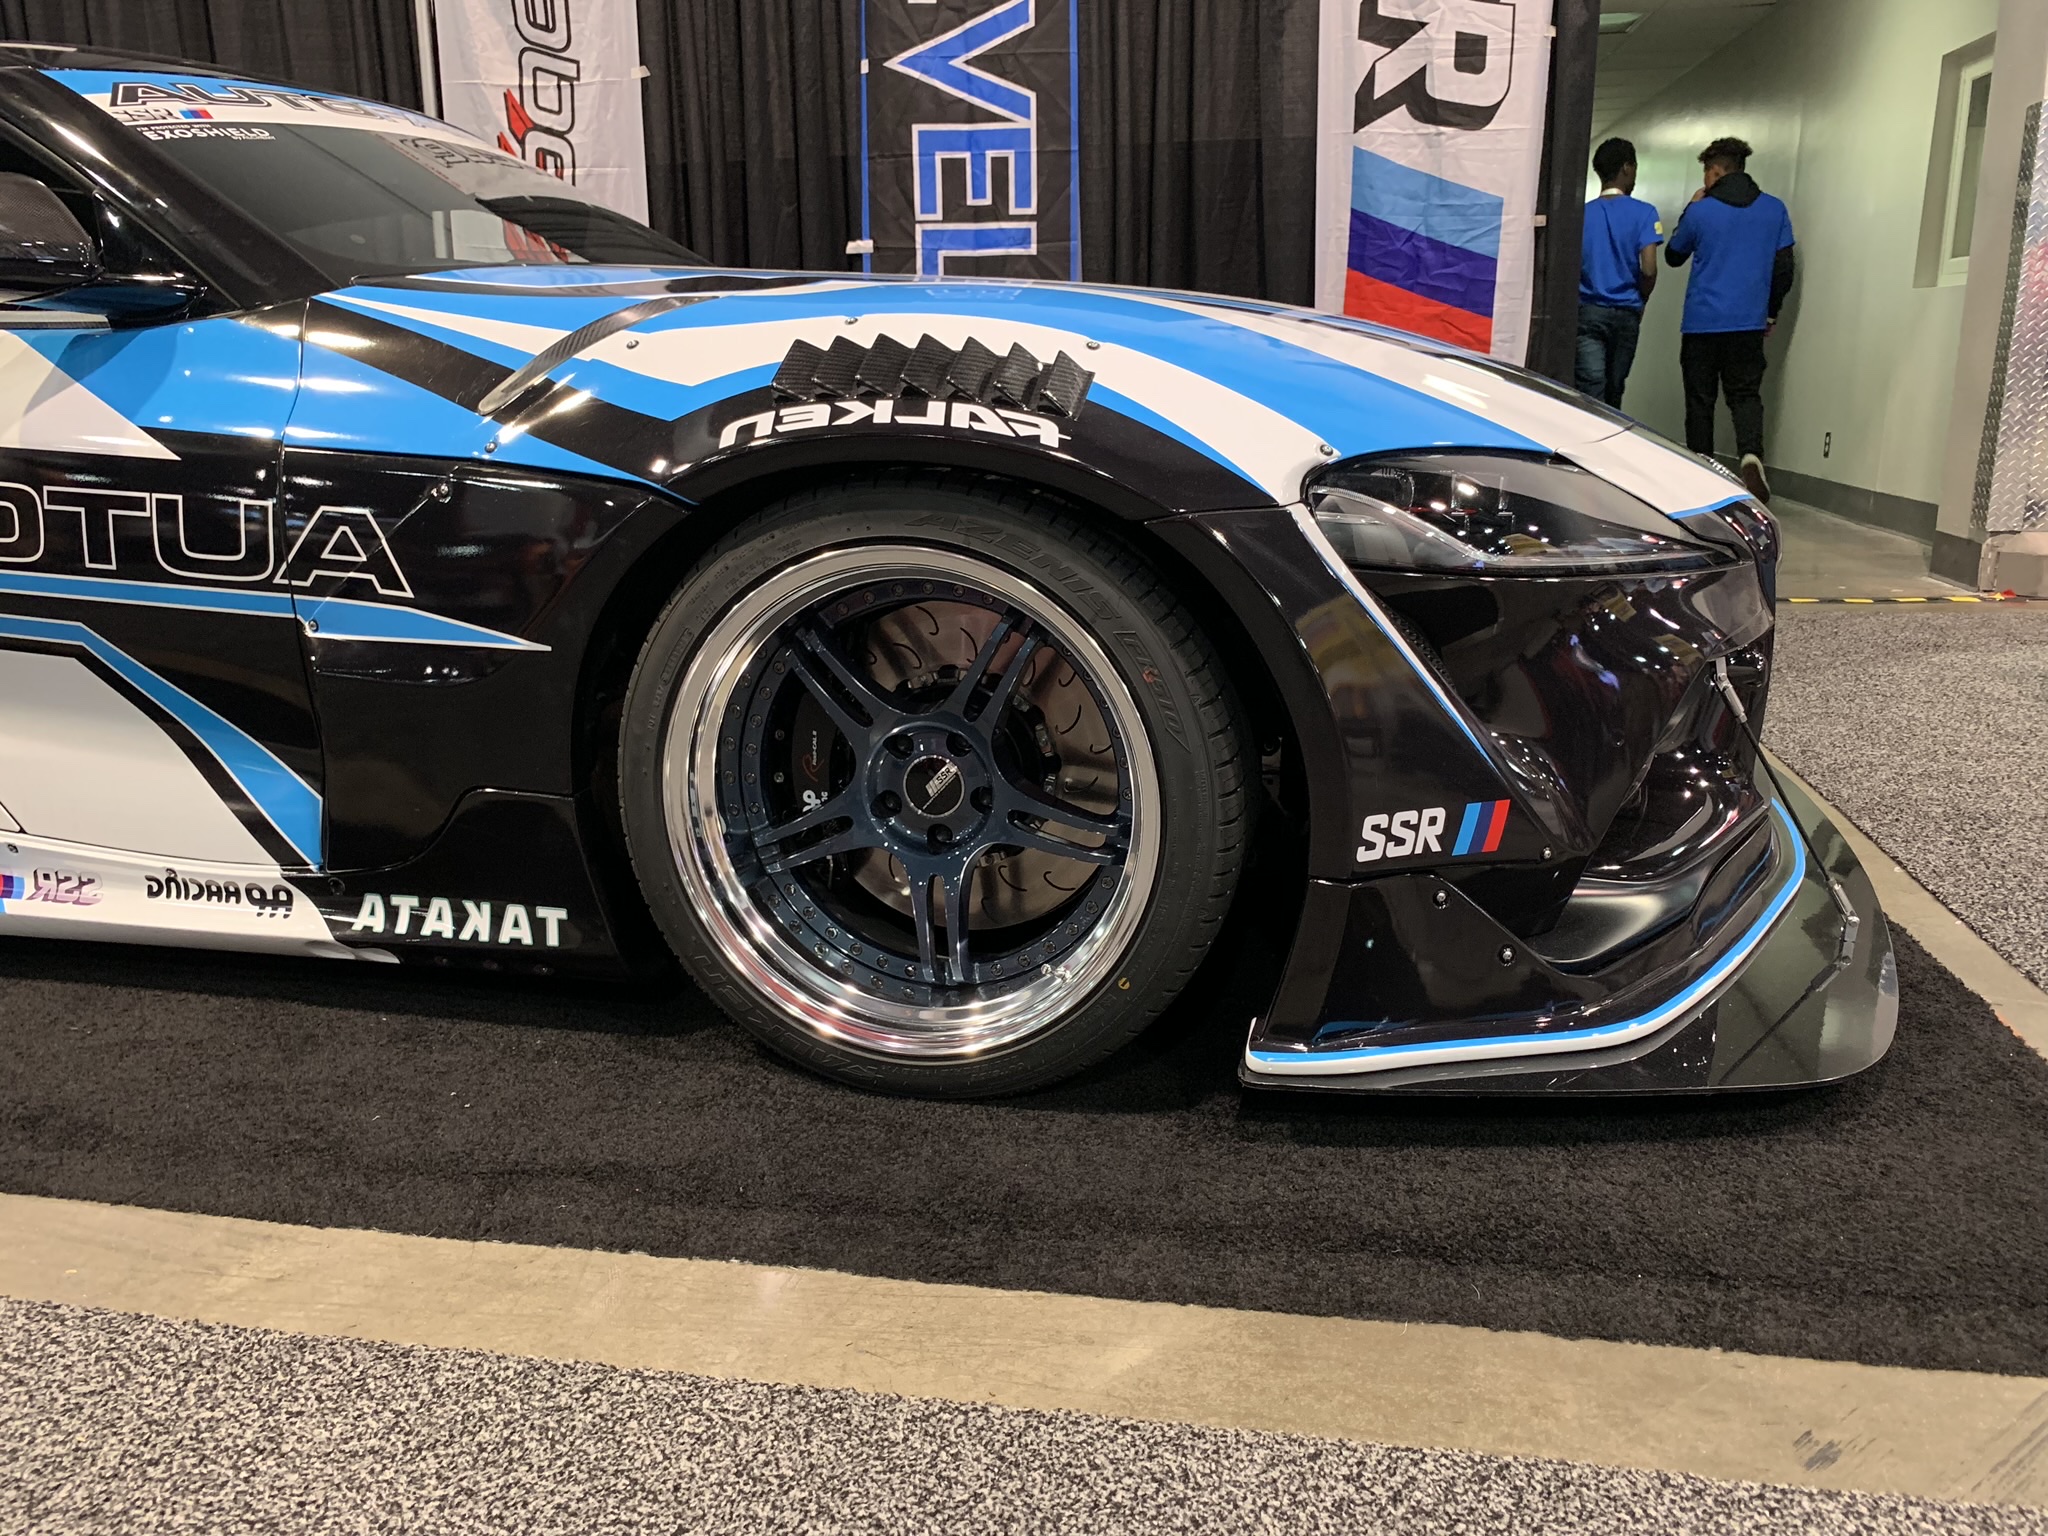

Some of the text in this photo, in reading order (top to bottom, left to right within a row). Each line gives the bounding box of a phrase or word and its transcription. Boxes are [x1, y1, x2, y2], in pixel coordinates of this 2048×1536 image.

[1353, 0, 1518, 134] R
[142, 127, 271, 141] EXOSHIELD
[882, 0, 1038, 278] VEL
[1356, 806, 1446, 863] SSR
